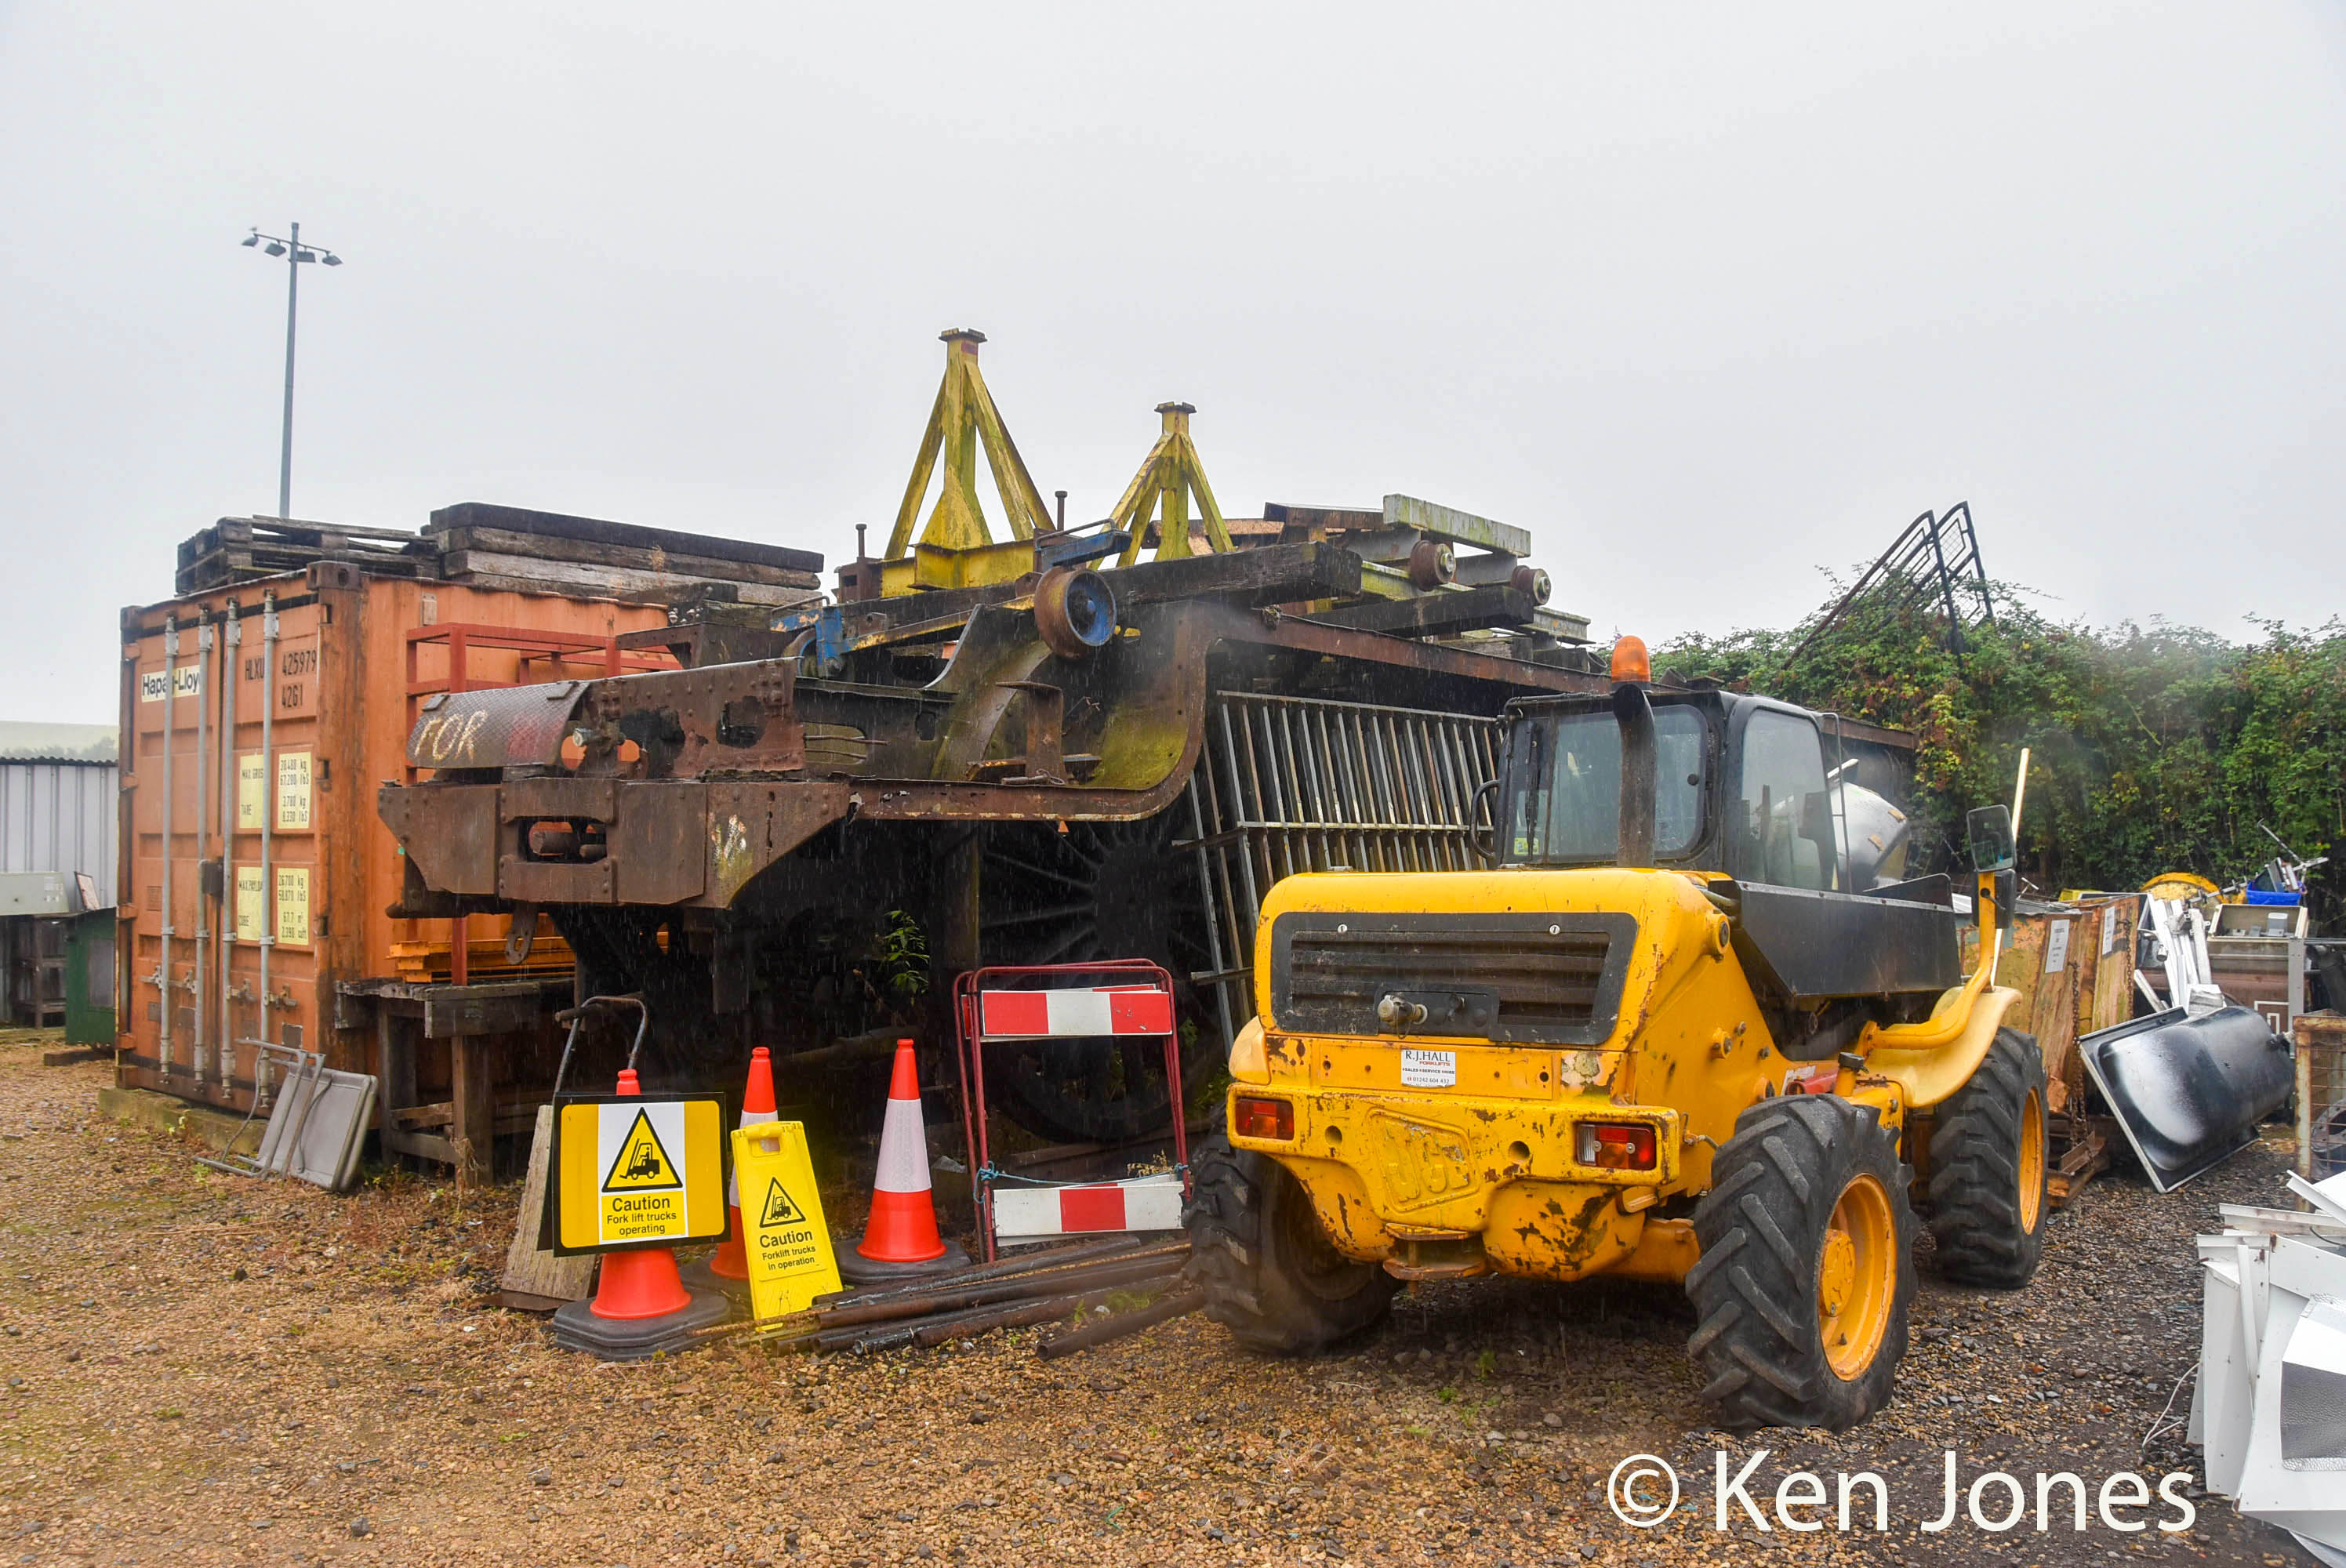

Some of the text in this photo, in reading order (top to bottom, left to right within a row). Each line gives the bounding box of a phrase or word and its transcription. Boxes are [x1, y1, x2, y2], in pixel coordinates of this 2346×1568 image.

[142, 668, 200, 696] Hapa-Lloy
[612, 1196, 670, 1212] Caution
[607, 1211, 677, 1224] Fork lift trucks
[619, 1223, 666, 1236] operating
[760, 1230, 812, 1248] Caution
[762, 1245, 816, 1261] Forklift trucks
[778, 1257, 815, 1270] operation
